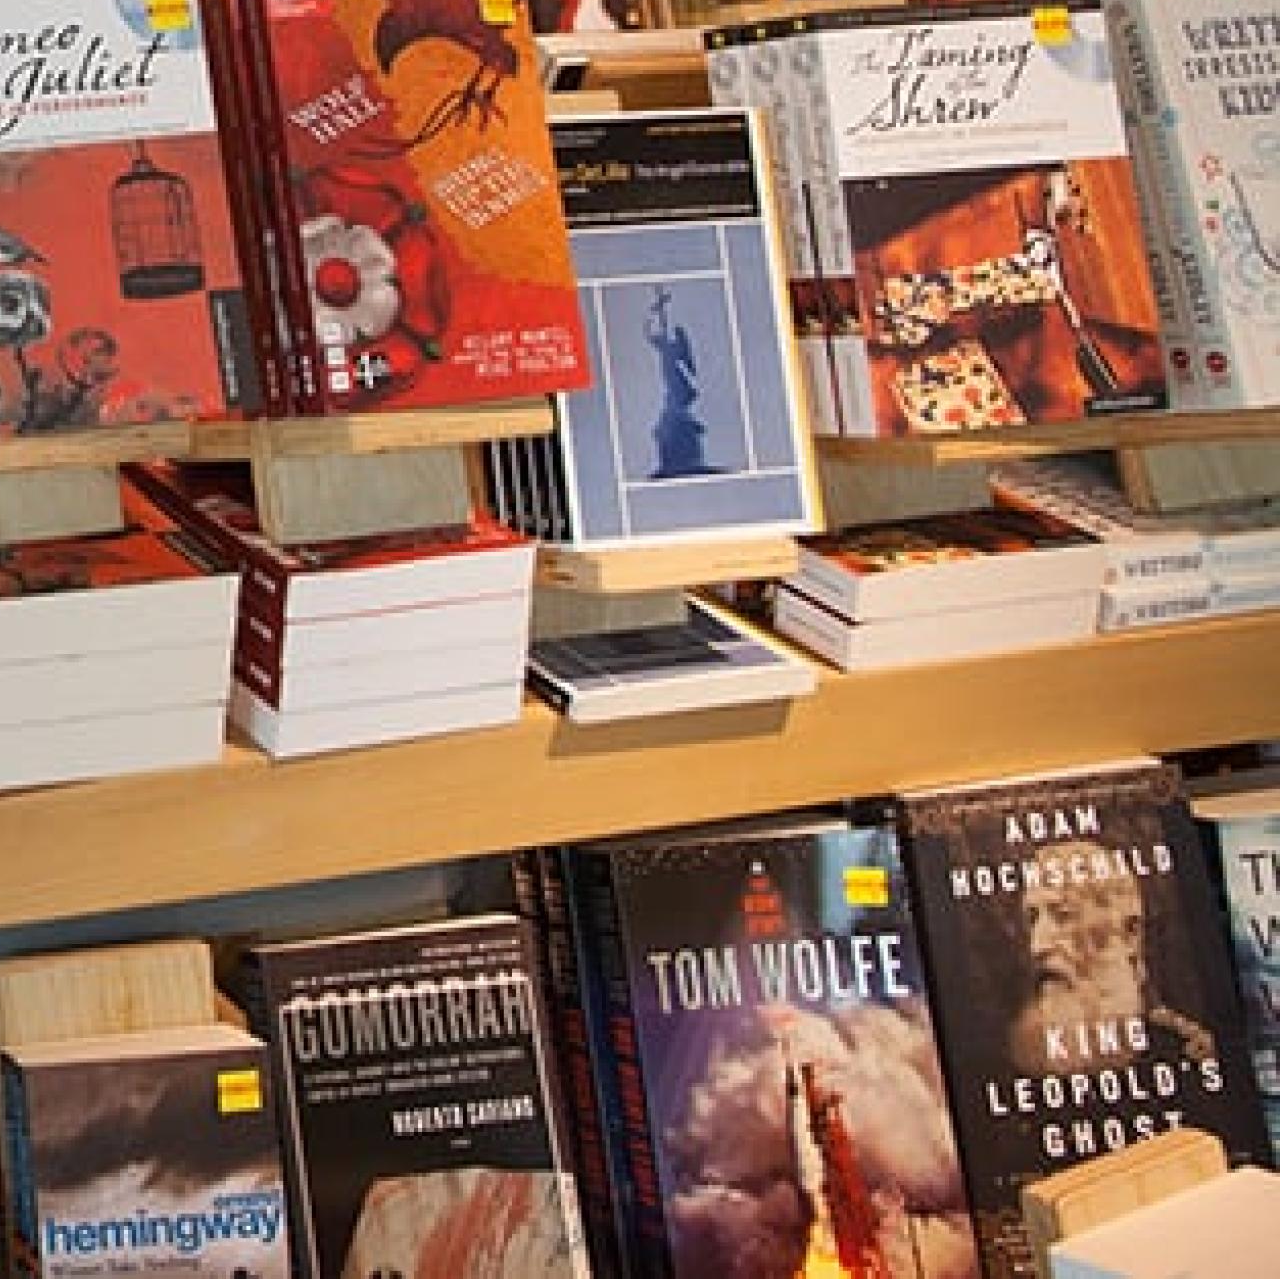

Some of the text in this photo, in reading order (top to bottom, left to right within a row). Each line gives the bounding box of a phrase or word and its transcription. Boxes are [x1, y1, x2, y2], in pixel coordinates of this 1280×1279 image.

[887, 28, 1038, 100] Taming
[843, 74, 1000, 136] Shrew
[1005, 805, 1101, 844] ADAM
[950, 844, 1173, 898] HOCHSCHILD
[646, 934, 909, 1015] TOM WOLFE
[292, 968, 535, 1063] GOMORRAH
[1046, 1018, 1149, 1060] KING
[987, 1058, 1224, 1117] LEOPOLD'S
[45, 1208, 281, 1255] hemingway
